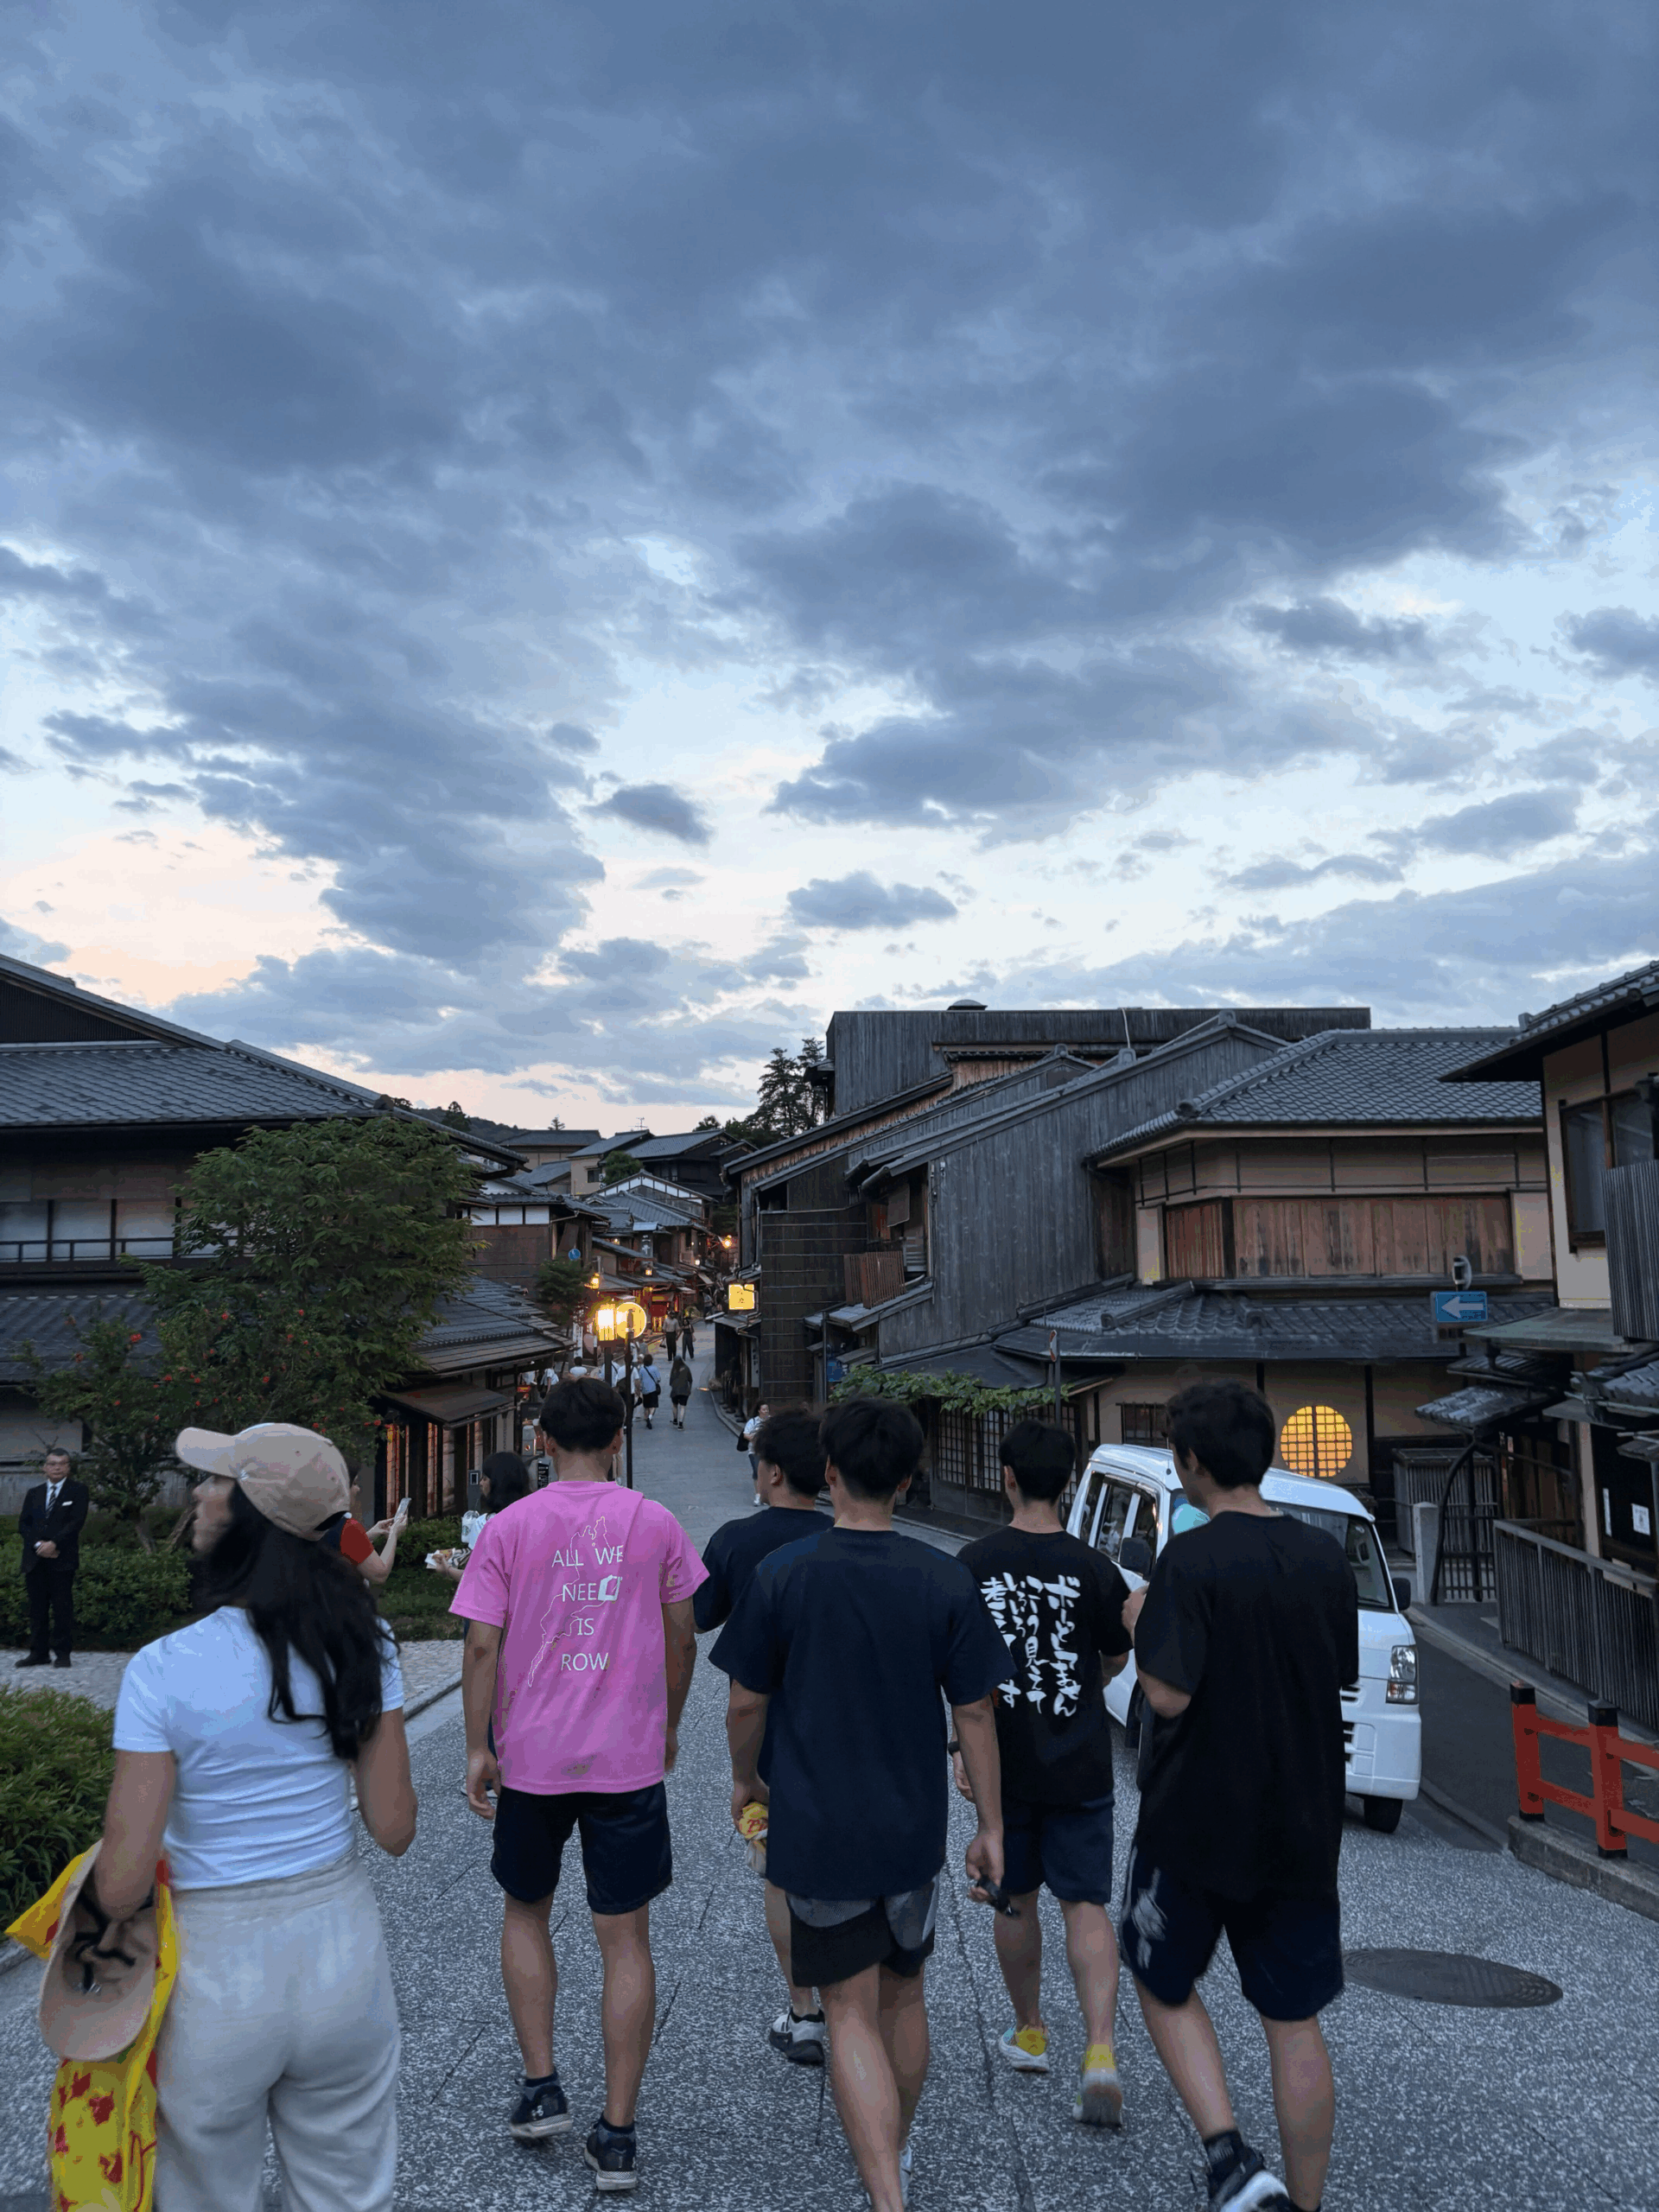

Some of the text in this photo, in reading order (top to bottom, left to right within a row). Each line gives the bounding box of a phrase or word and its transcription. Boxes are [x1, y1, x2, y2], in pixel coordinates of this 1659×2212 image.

[551, 1544, 624, 1568] ALL WE
[1002, 1572, 1027, 1638] いろいろ
[576, 1618, 594, 1636] IS
[1025, 1575, 1051, 1714] こう見えて
[561, 1651, 609, 1671] ROW
